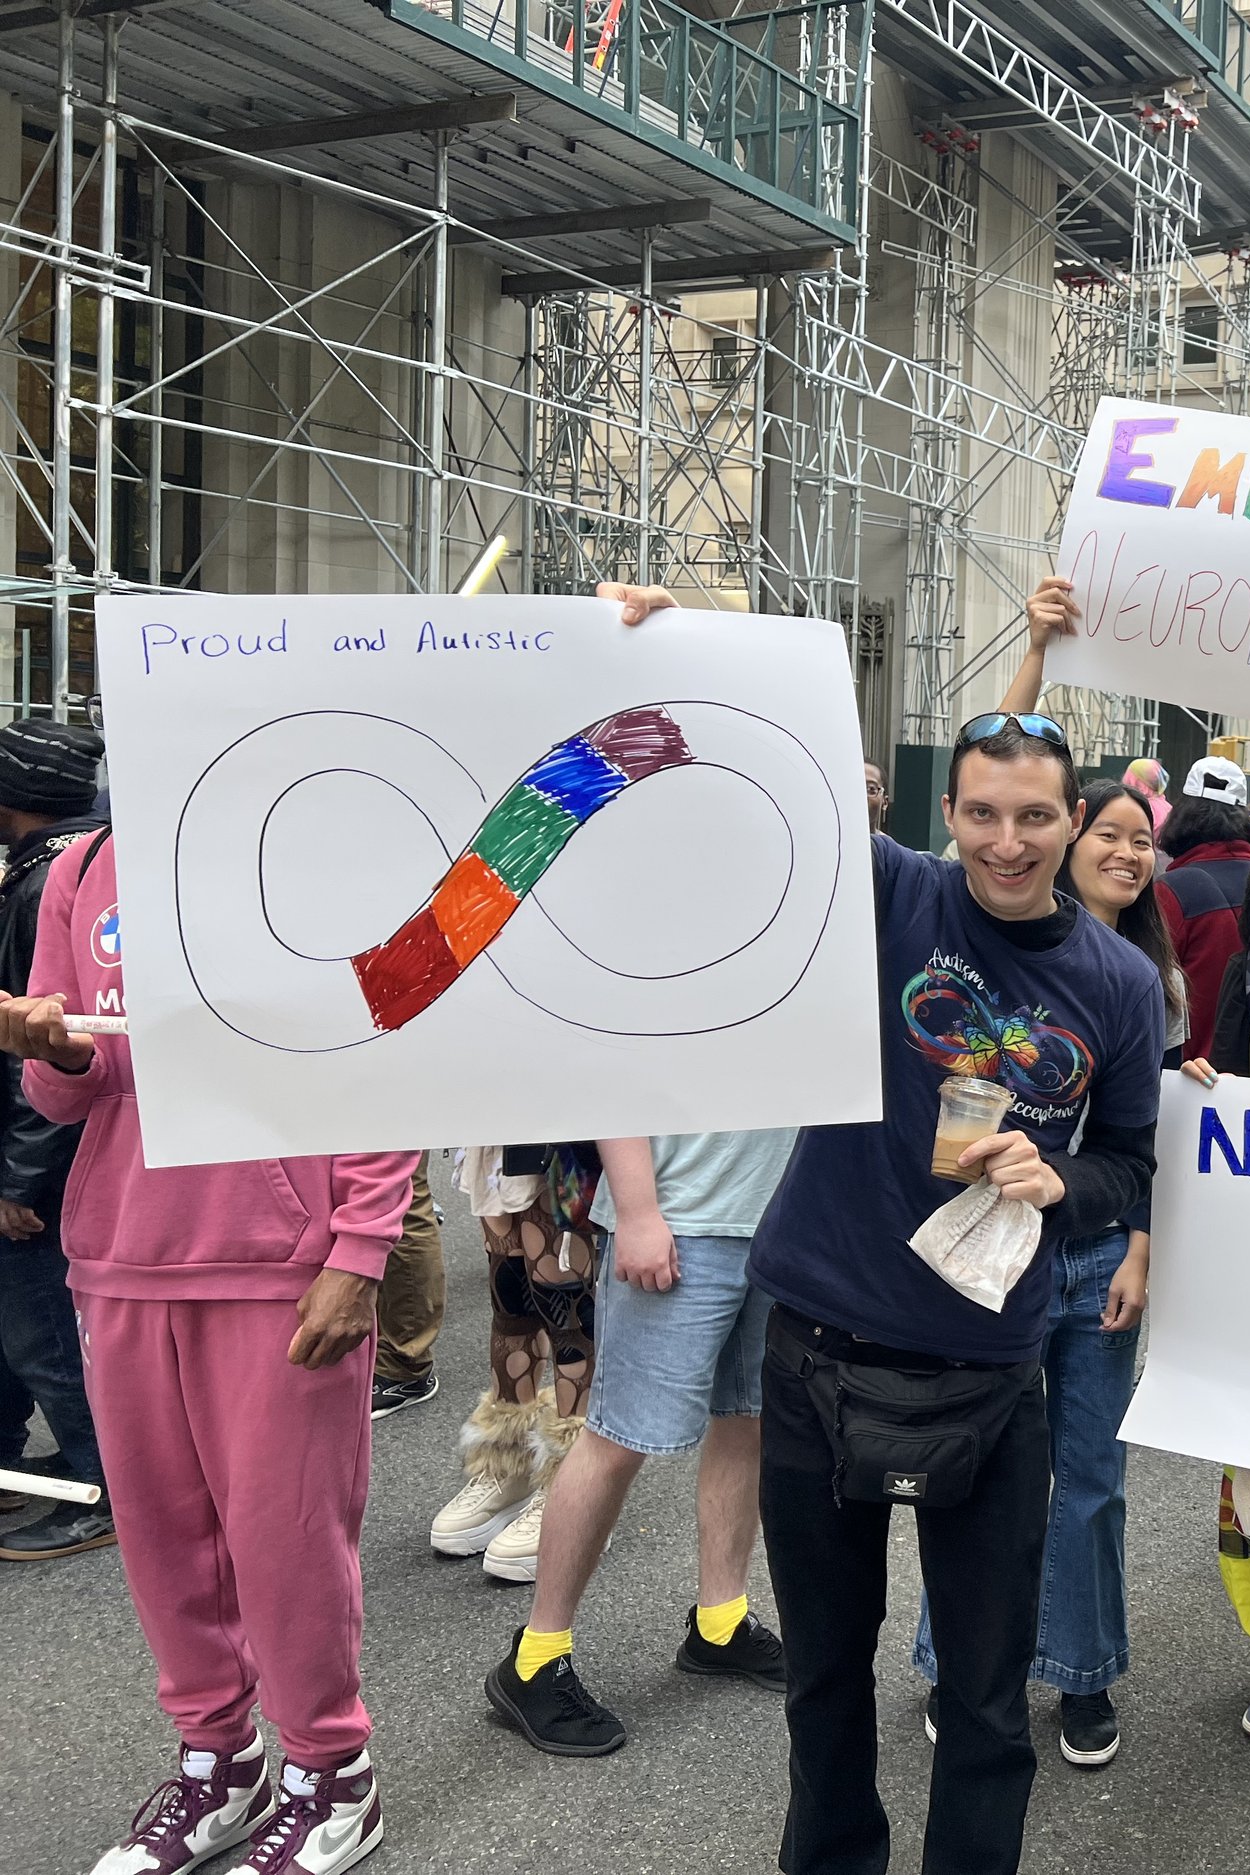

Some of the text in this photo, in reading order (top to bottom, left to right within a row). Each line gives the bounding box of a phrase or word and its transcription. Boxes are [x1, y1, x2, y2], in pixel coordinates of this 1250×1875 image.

[141, 618, 555, 675] Proud and Autistic
[928, 947, 986, 991] Autism
